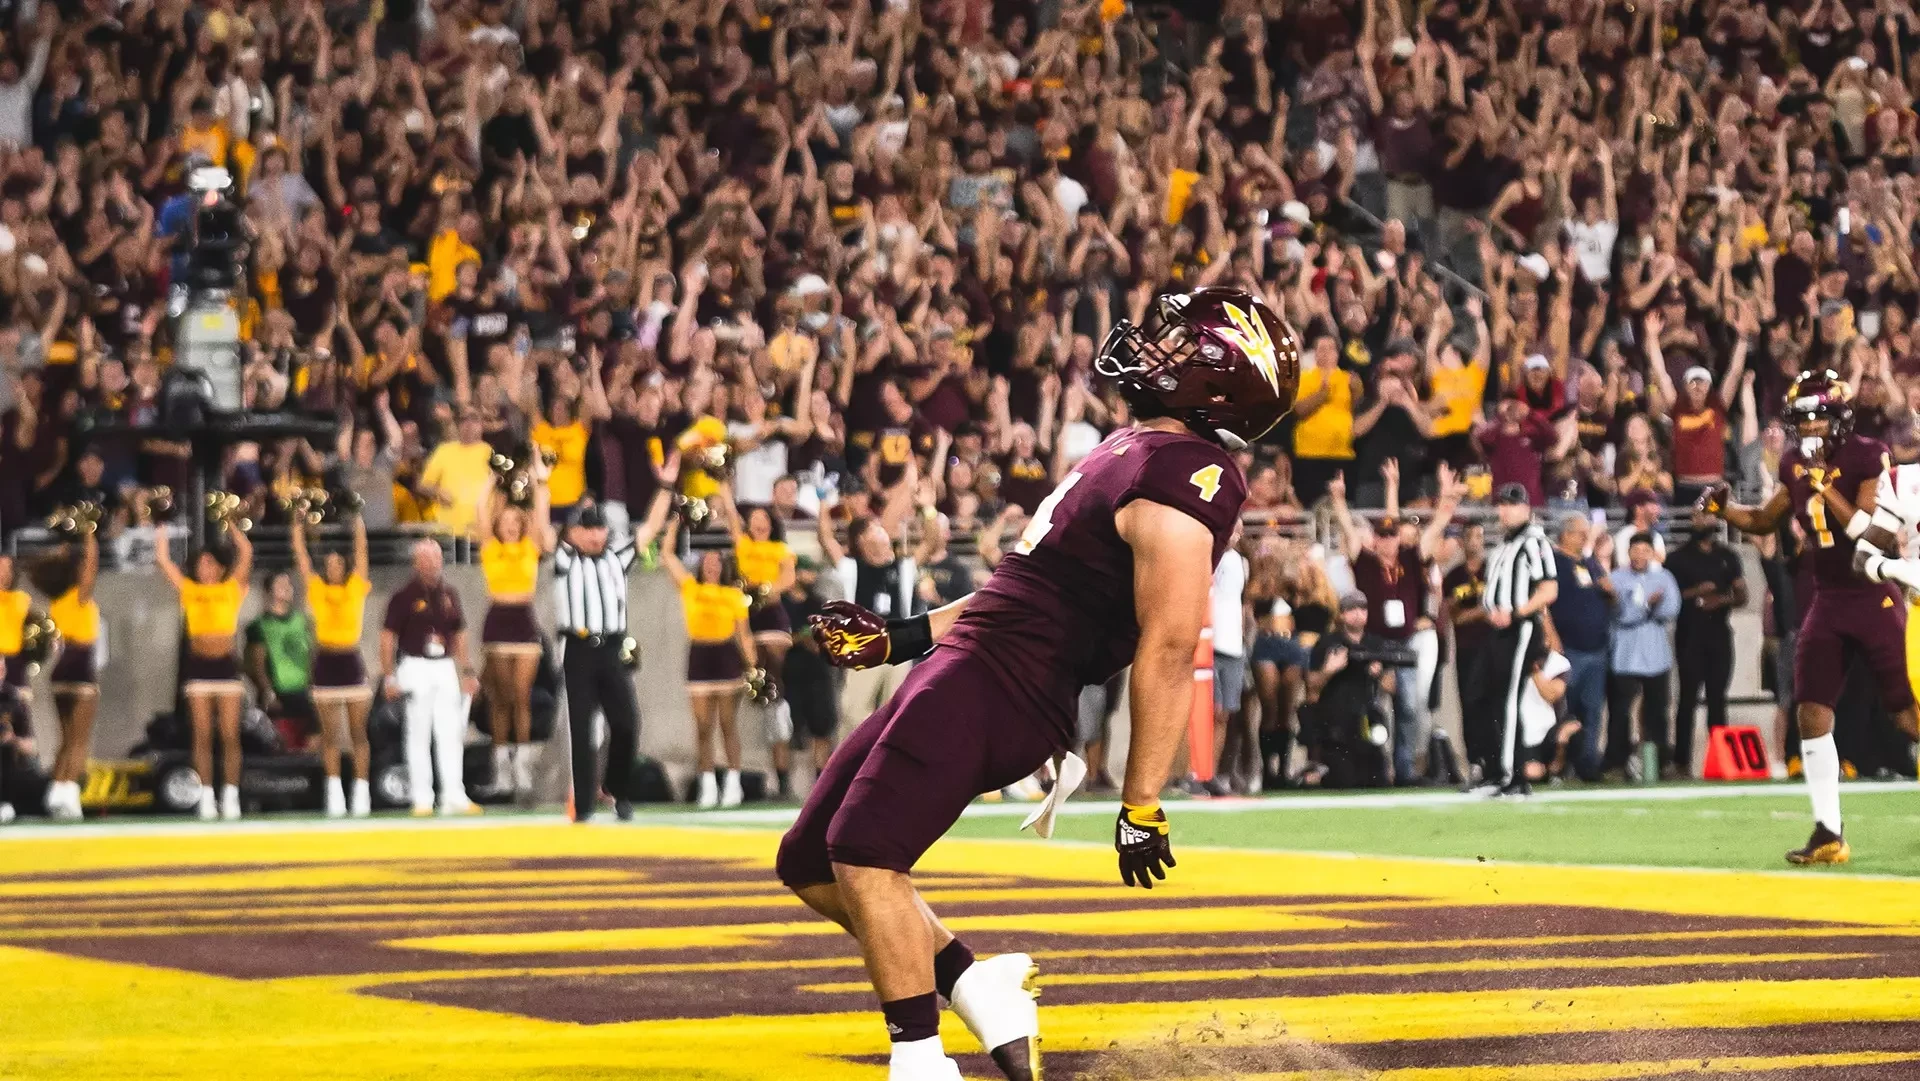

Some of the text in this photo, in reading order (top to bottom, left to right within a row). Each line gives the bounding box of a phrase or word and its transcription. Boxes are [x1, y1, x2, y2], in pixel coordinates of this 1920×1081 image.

[1189, 463, 1225, 502] 4
[1807, 493, 1835, 548] 1
[1724, 731, 1767, 770] 10
